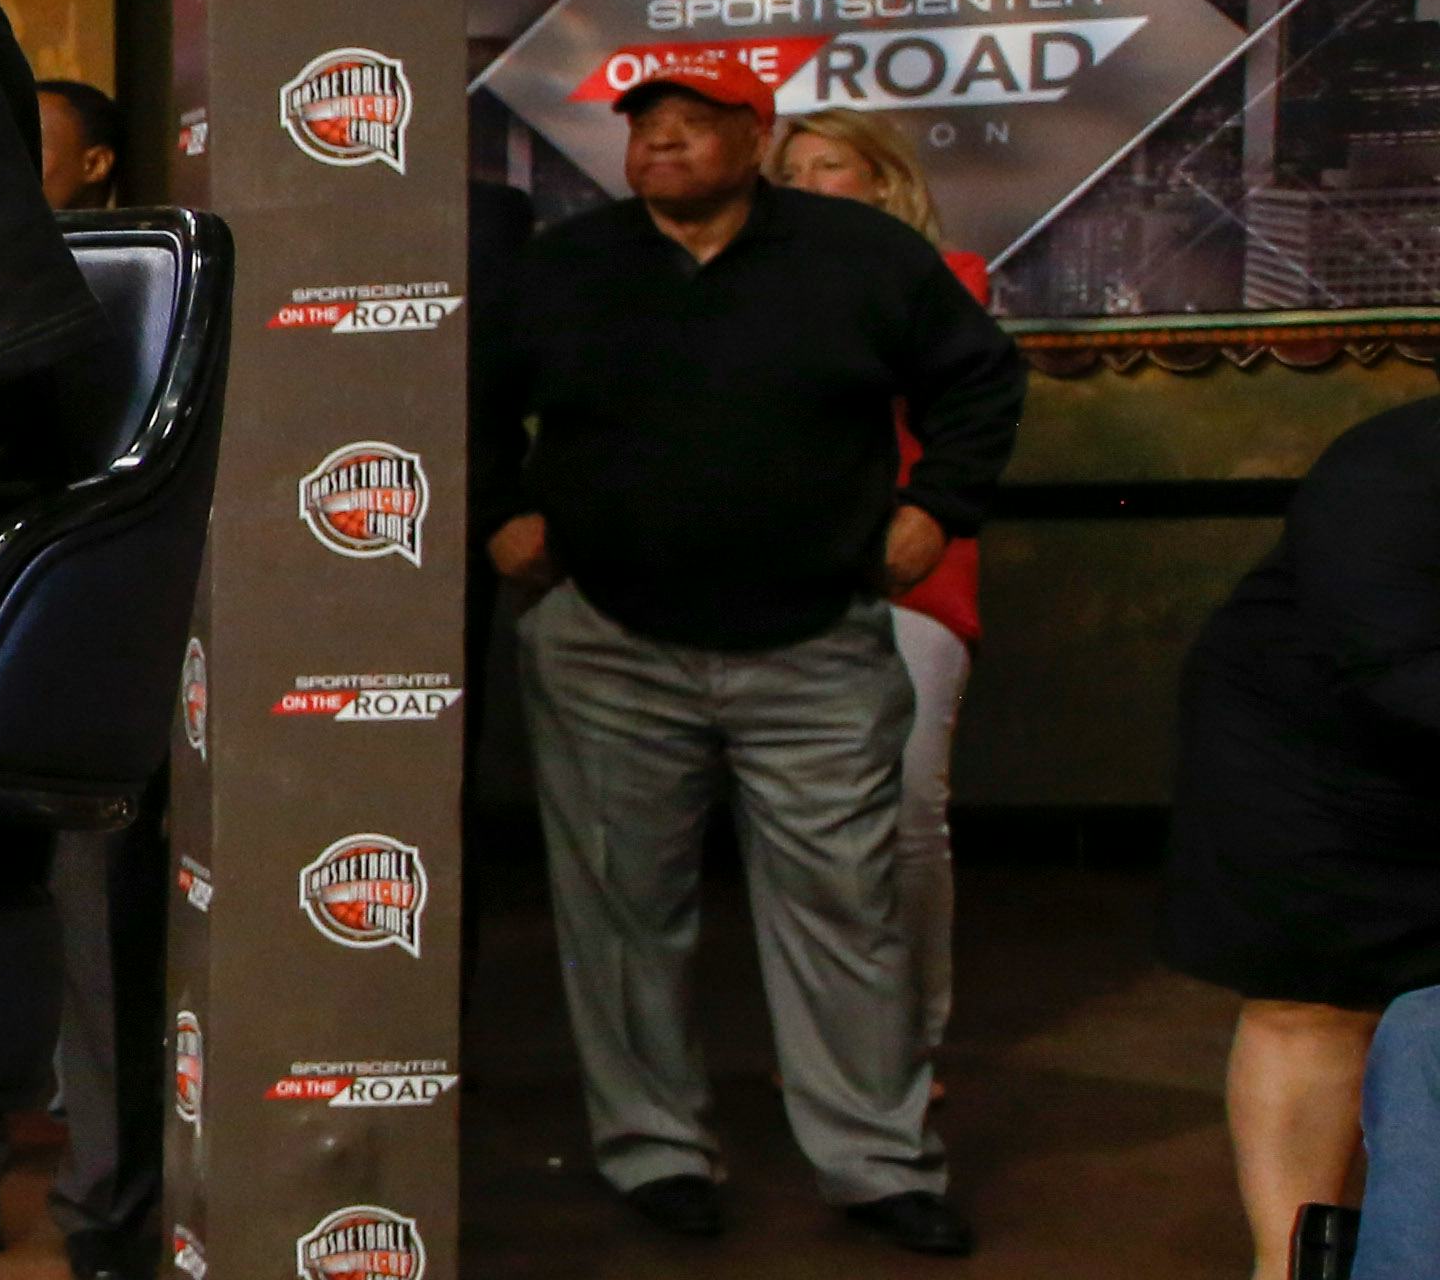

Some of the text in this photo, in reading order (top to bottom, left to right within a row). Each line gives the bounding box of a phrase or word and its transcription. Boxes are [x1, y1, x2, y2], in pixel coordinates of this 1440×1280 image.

[816, 32, 1095, 101] ROAD
[279, 303, 447, 328] ON THE ROAD
[282, 694, 447, 715] ON THE ROAD
[275, 1079, 443, 1101] ON THE ROAD
